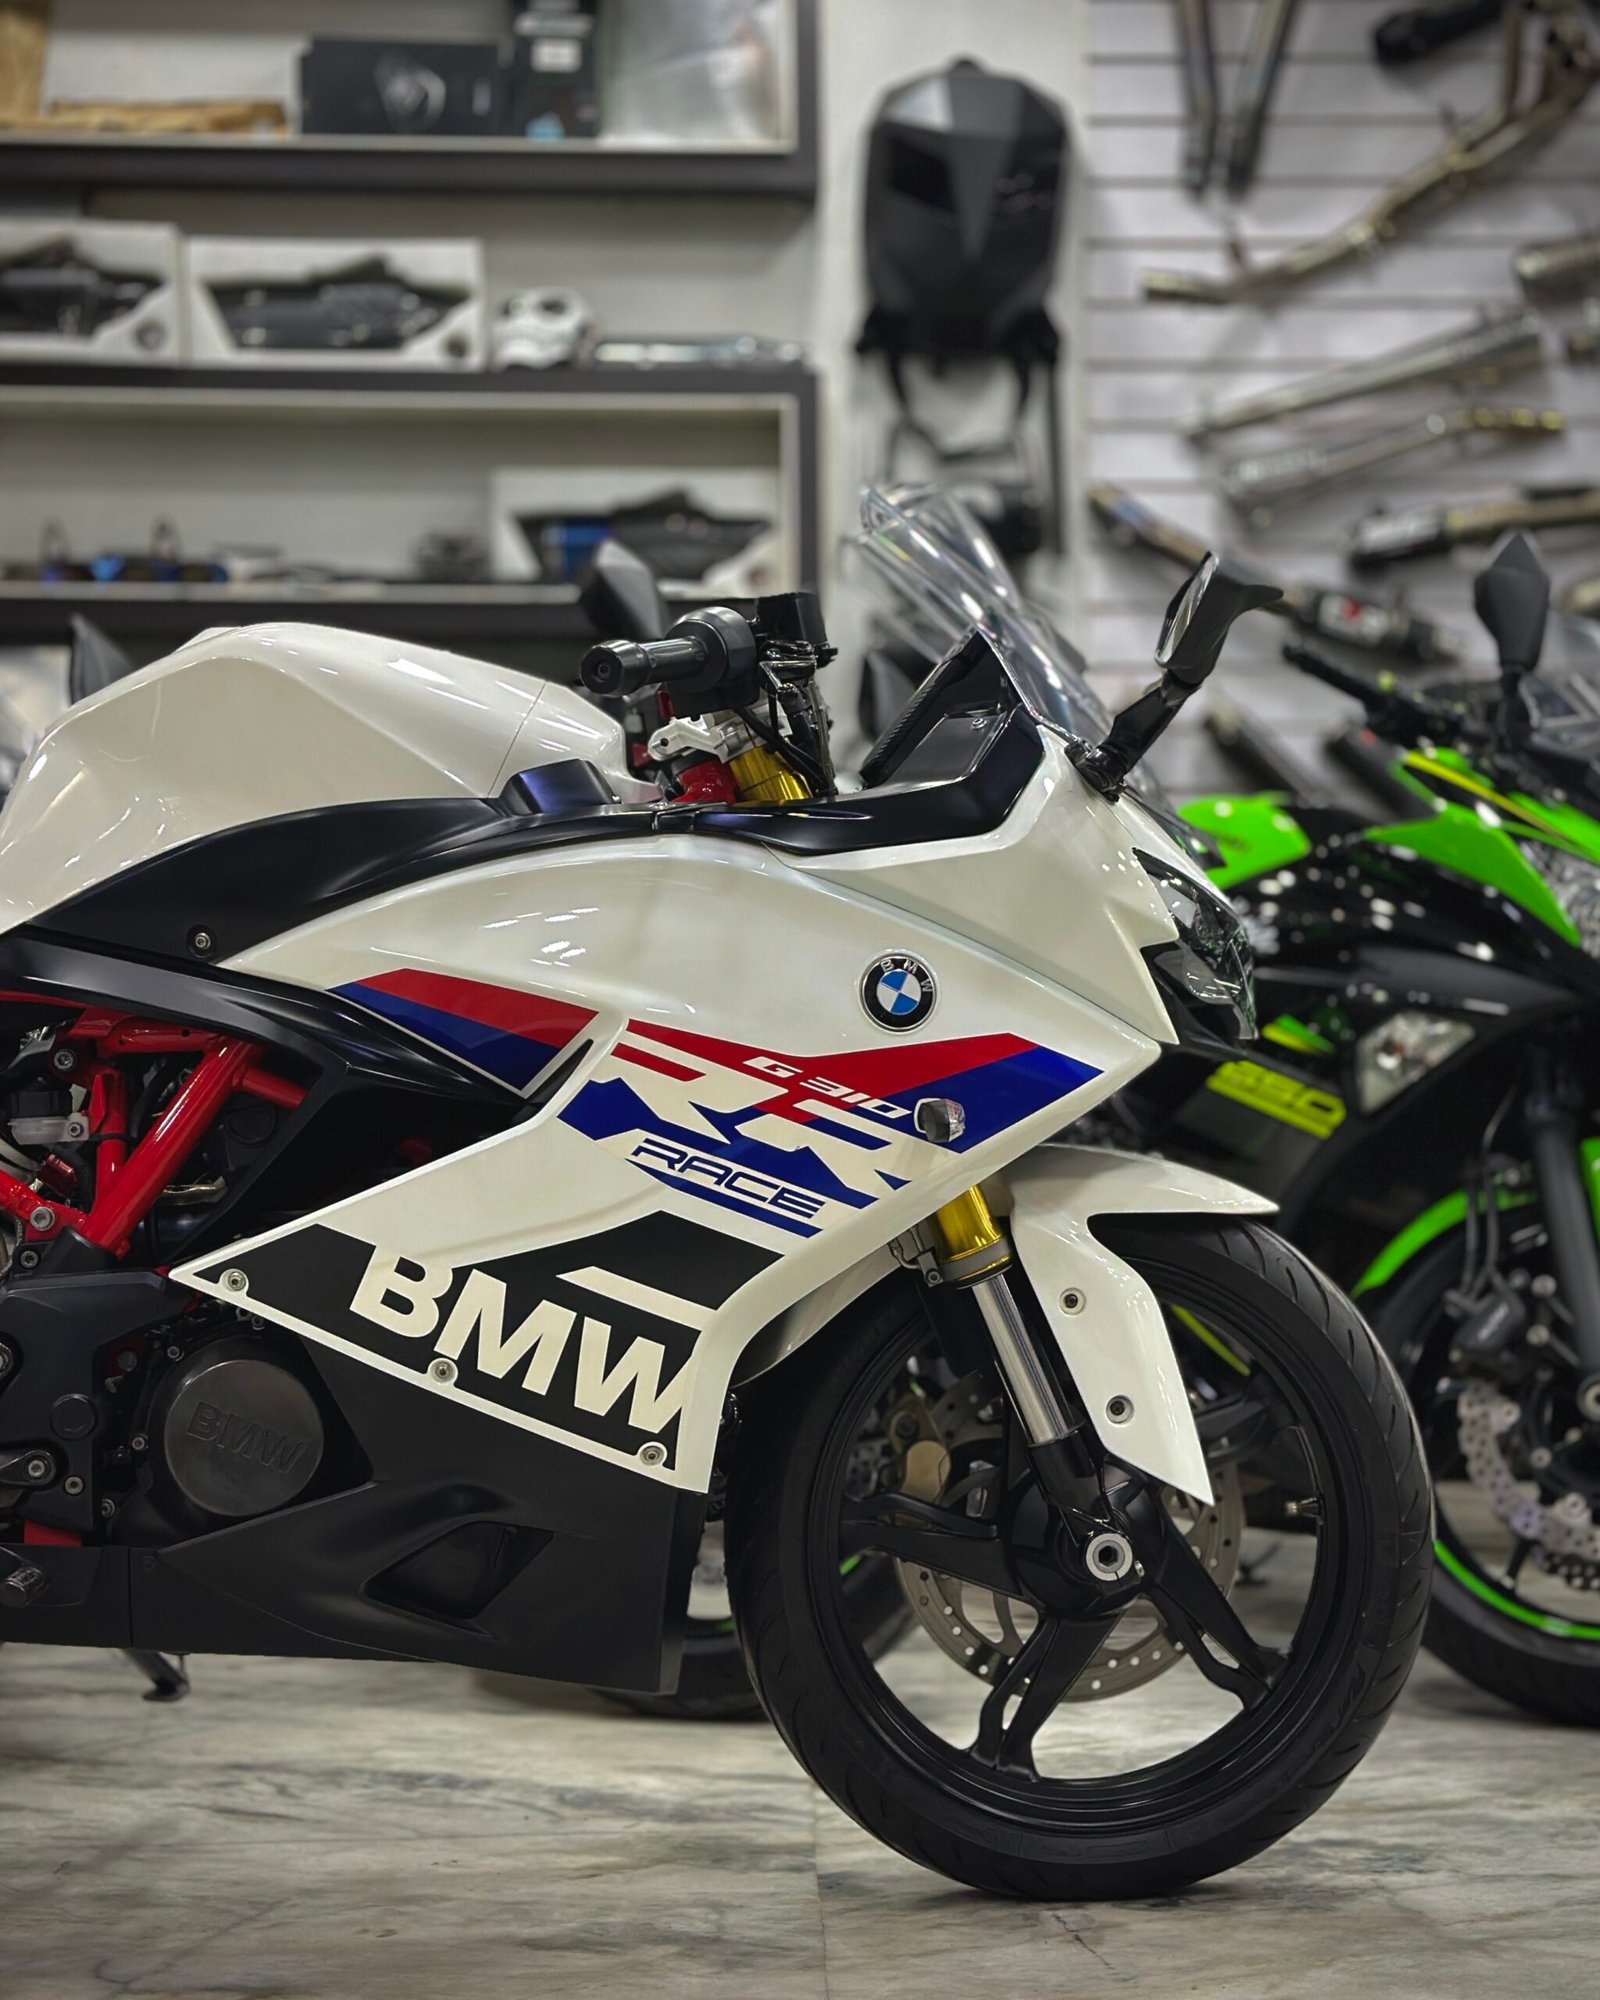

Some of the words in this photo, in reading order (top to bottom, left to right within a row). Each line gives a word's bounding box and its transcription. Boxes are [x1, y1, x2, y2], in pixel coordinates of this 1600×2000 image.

[880, 957, 934, 993] BMW
[742, 1056, 803, 1078] G
[799, 1076, 912, 1118] 310
[630, 1137, 826, 1219] RACE
[349, 1244, 694, 1434] BMW
[187, 1400, 306, 1474] BMW
